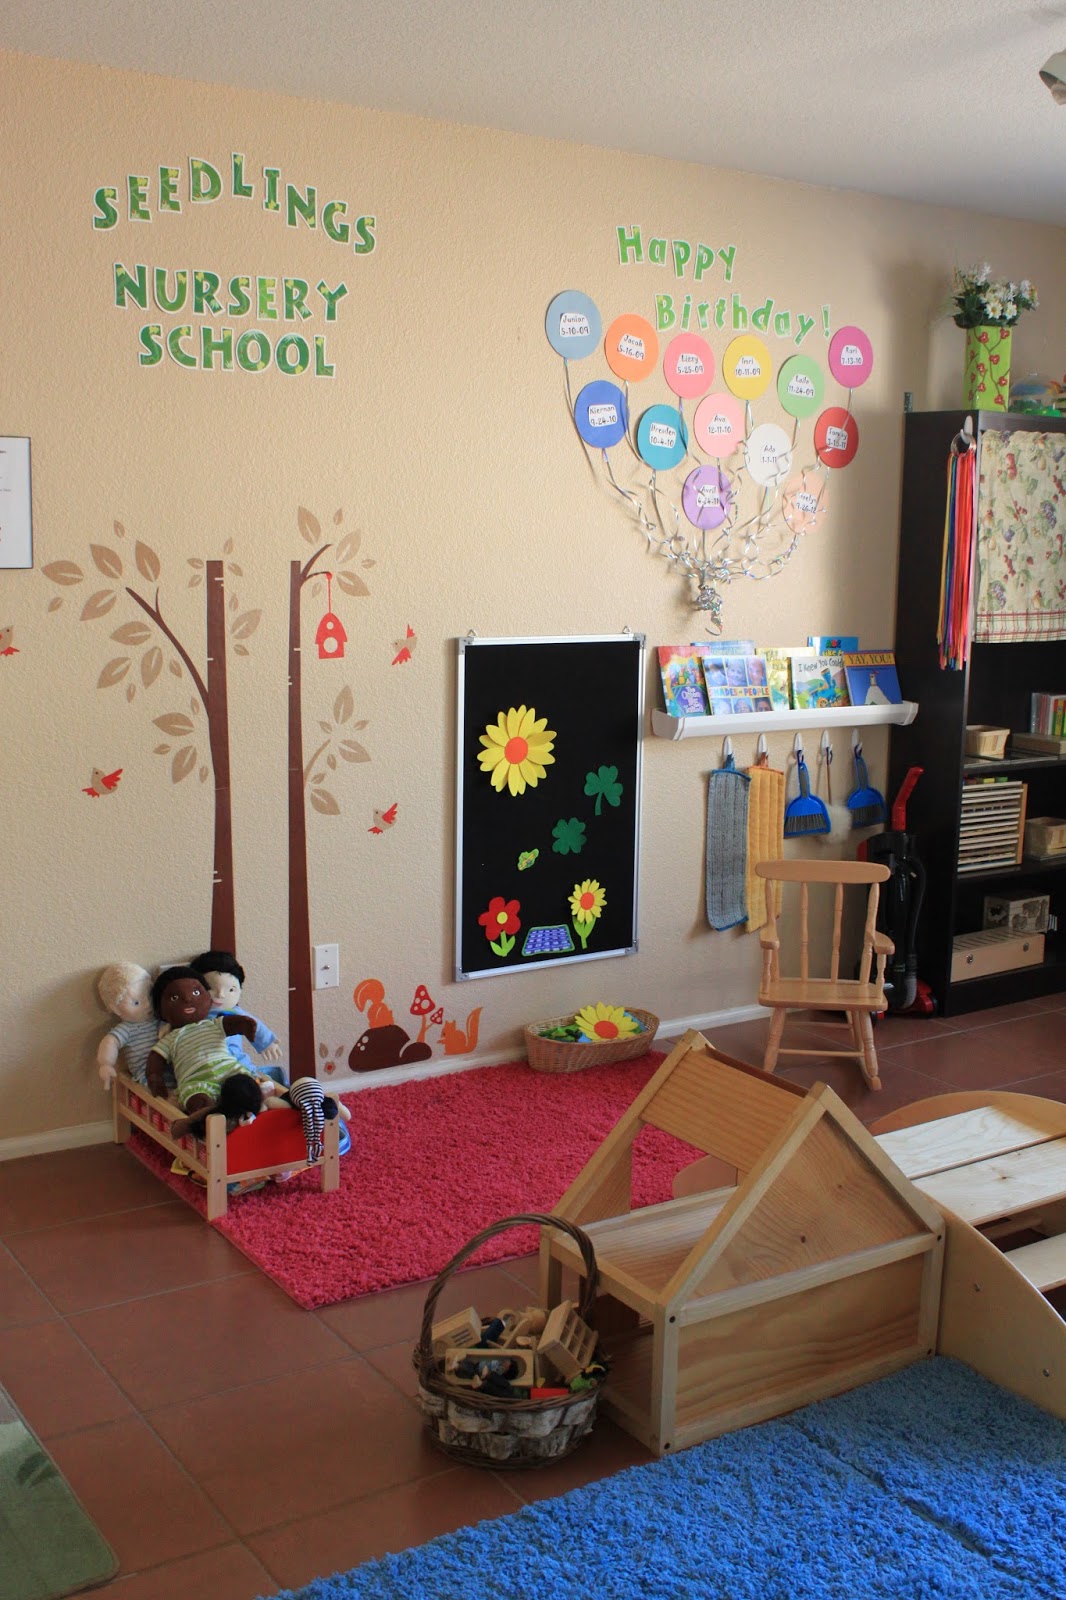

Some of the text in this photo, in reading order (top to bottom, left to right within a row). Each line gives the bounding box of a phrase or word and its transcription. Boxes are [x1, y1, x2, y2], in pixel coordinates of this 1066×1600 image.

[92, 152, 377, 255] SEEDLINGS
[615, 224, 737, 282] Happy
[113, 262, 349, 322] NURSERY
[562, 315, 585, 323] Junior
[623, 335, 643, 348] Jacob
[655, 293, 831, 347] Birthday!
[138, 324, 336, 378] SCHOOL
[869, 653, 892, 664] YOU!
[743, 687, 770, 696] PEOPLE
